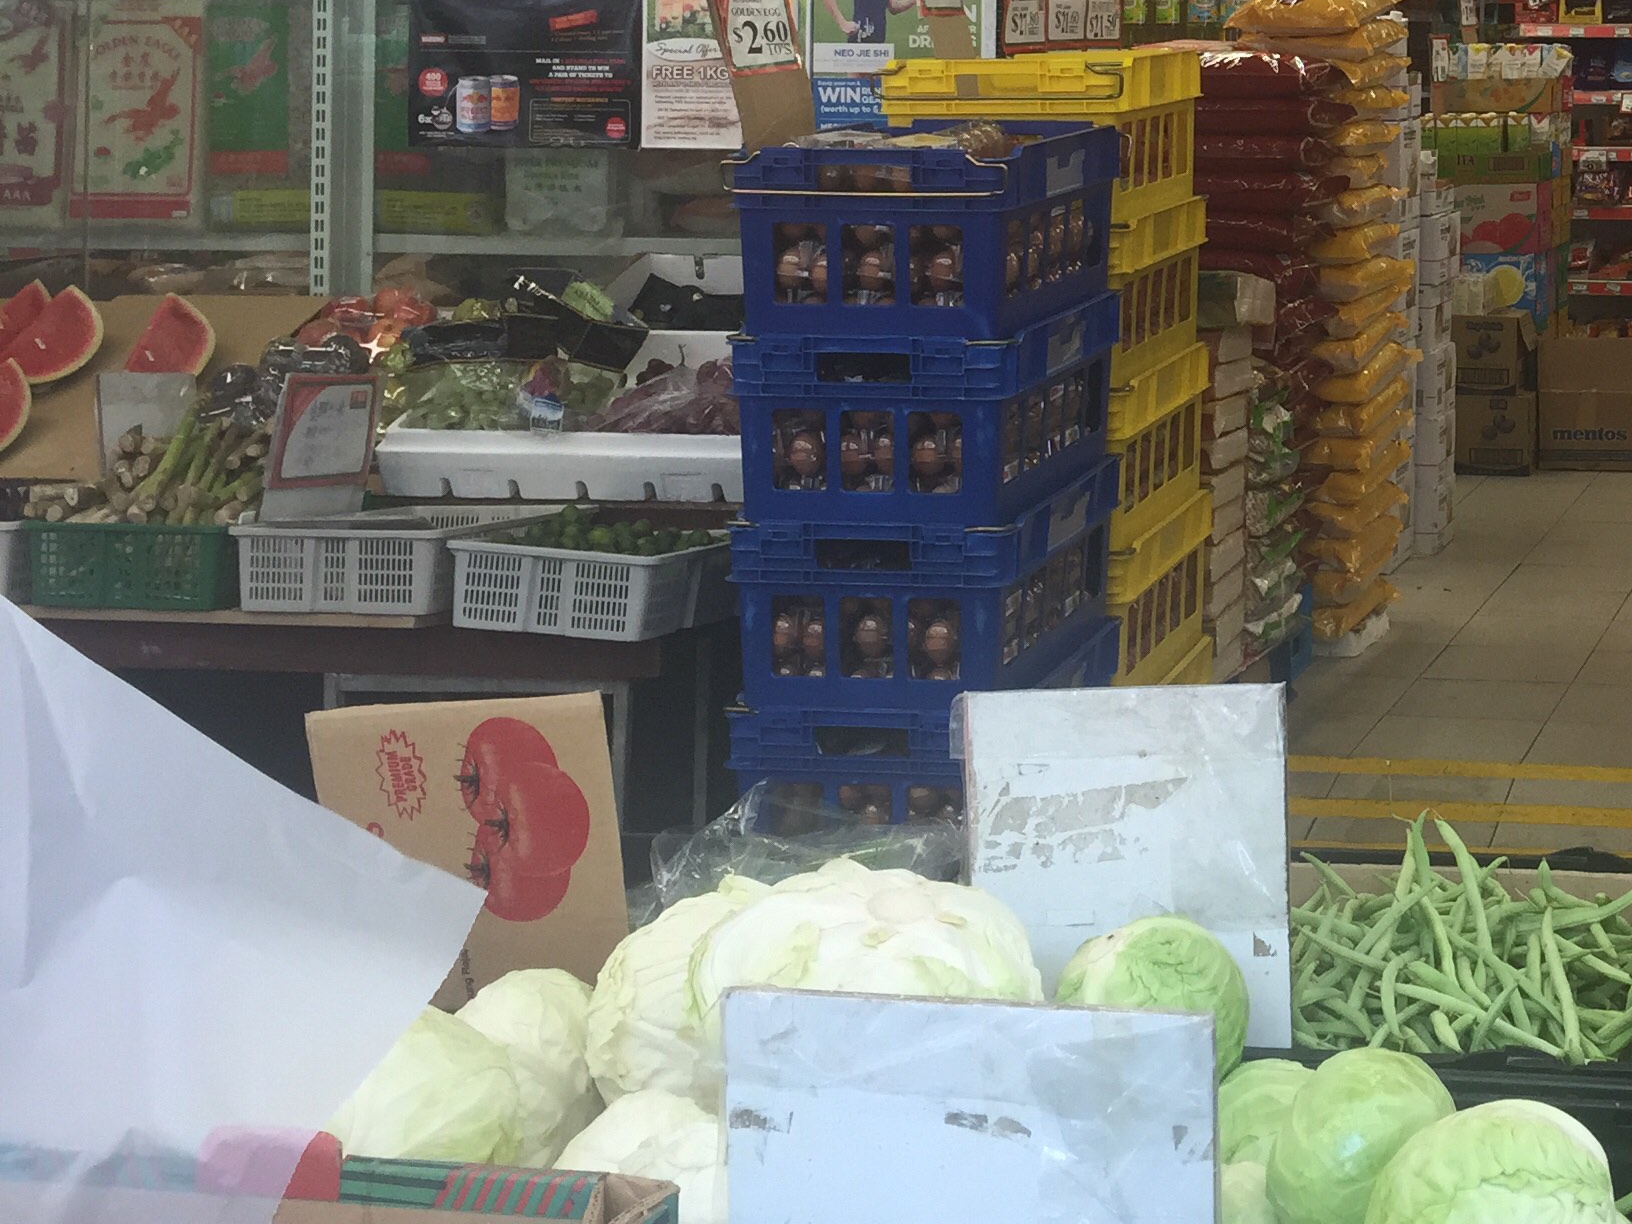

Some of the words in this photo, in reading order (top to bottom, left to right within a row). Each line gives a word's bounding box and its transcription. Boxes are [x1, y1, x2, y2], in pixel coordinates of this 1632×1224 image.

[656, 43, 692, 55] Special
[696, 42, 717, 56] Offer
[834, 49, 854, 57] NEO
[857, 49, 870, 57] JIE
[873, 49, 889, 57] SHI
[652, 65, 693, 79] FREE
[698, 66, 729, 80] 1KG
[818, 87, 860, 103] WIN
[1552, 428, 1628, 441] mentos
[387, 751, 408, 803] PREMIUM
[401, 756, 418, 794] GRADE
